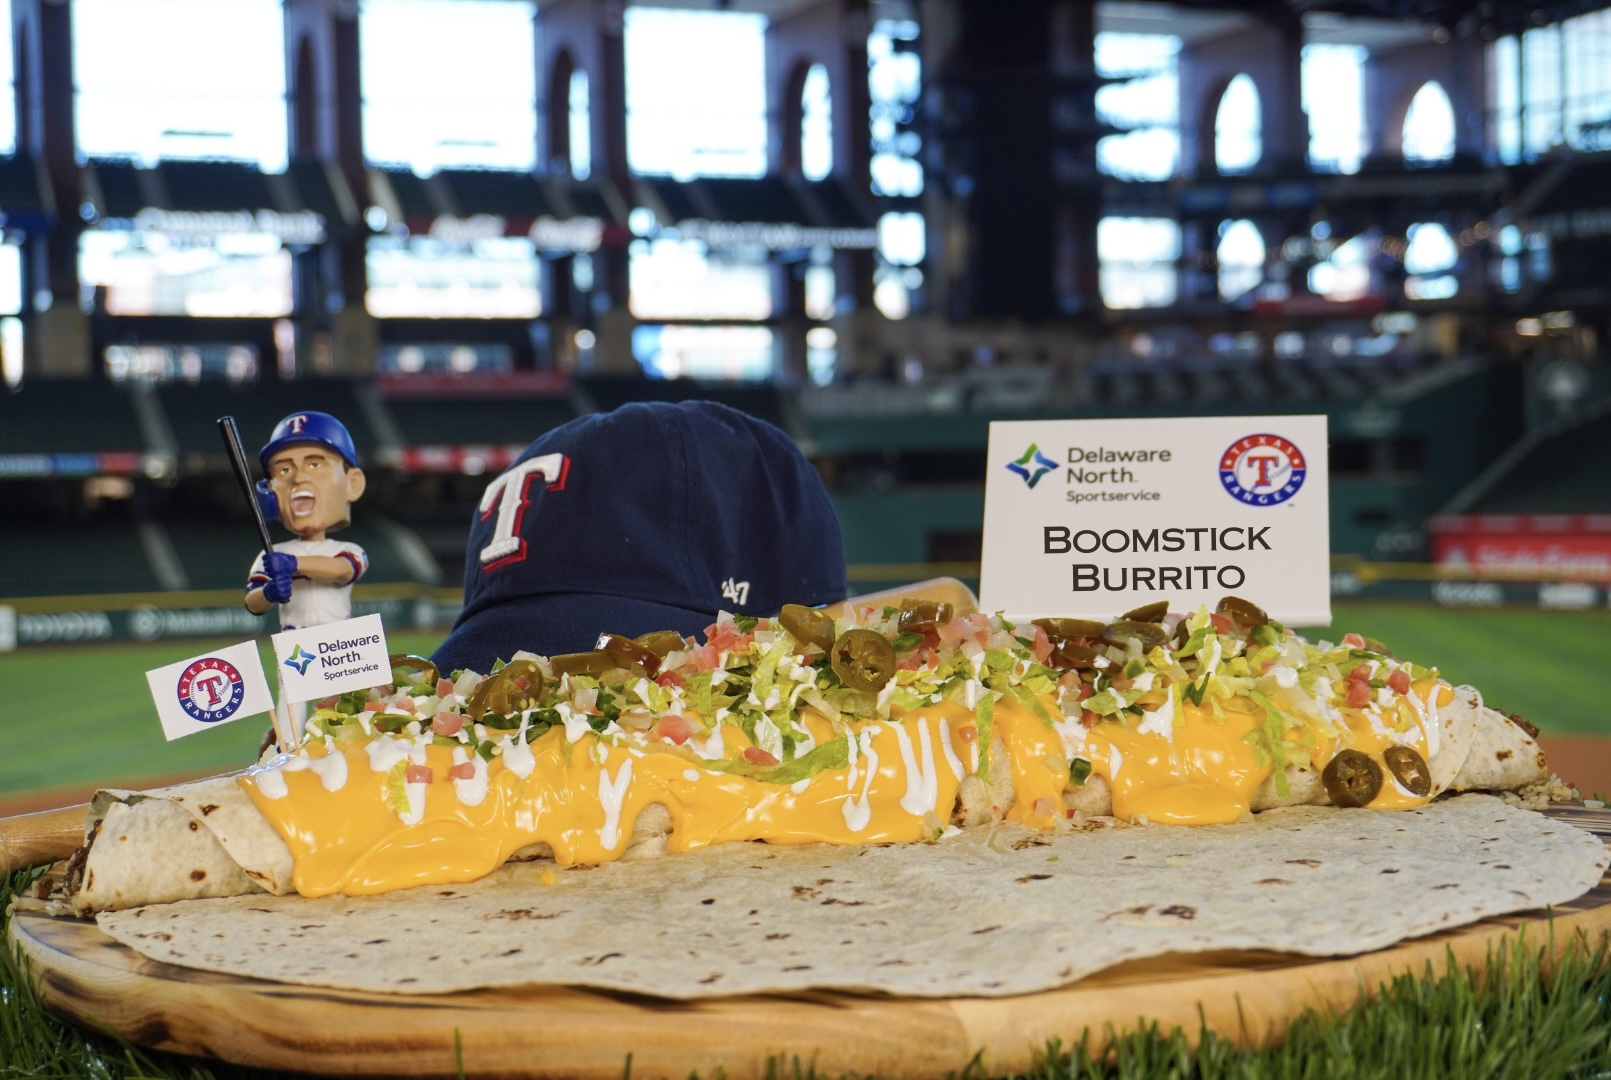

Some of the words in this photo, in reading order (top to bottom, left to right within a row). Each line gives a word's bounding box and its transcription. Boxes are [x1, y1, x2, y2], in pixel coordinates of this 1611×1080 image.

[286, 414, 308, 435] T
[1068, 447, 1172, 463] Delaware
[1230, 436, 1294, 455] TEXAS
[1067, 467, 1133, 484] North
[1247, 456, 1279, 486] T
[1066, 490, 1161, 504] Sportservice
[1224, 475, 1302, 504] RANGERS
[479, 452, 570, 574] T
[1044, 525, 1272, 554] BOOMSTICK
[1073, 563, 1246, 592] BURRITO
[318, 634, 380, 654] Delaware
[320, 651, 361, 668] North
[183, 661, 230, 683] TEXAS
[324, 663, 379, 681] Sportservice
[196, 675, 222, 706] T
[185, 687, 242, 719] RANGERS
